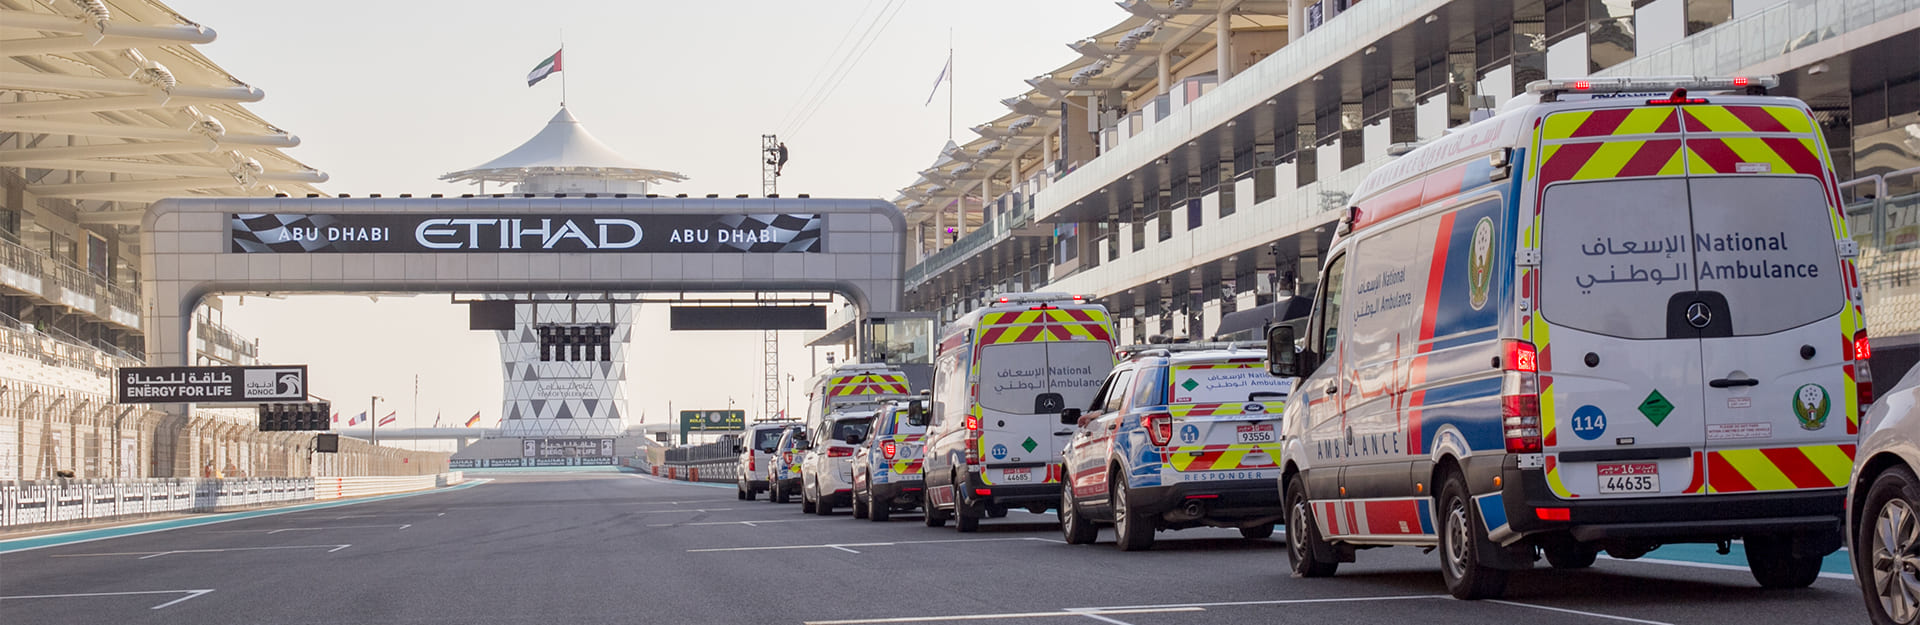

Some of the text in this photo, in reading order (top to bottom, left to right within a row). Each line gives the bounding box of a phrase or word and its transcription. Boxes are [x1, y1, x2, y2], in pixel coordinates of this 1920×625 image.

[278, 227, 390, 241] ABU DHABI
[415, 218, 643, 249] ETIHAD
[670, 229, 777, 243] ABU DHABI
[1581, 235, 1686, 259] الإسعاف
[1696, 232, 1788, 252] National
[1382, 265, 1406, 288] National
[1699, 260, 1819, 280] Ambulance
[1575, 262, 1688, 294] الوطني
[1381, 291, 1412, 313] Ambulance
[997, 367, 1045, 379] الإسعاف
[1049, 365, 1092, 376] National
[1207, 372, 1246, 381] الإسعاف
[127, 372, 232, 388] طاقة للحياة
[994, 379, 1046, 393] الوطني
[127, 386, 232, 397] ENERGY FOR LIFE
[1574, 415, 1604, 431] 114
[1184, 432, 1196, 441] 11
[1242, 431, 1270, 441] 93556
[1317, 431, 1399, 460] AMBULANCE
[1184, 471, 1263, 481] RESPONDER
[1621, 464, 1635, 474] 16
[1607, 476, 1652, 491] 44635
